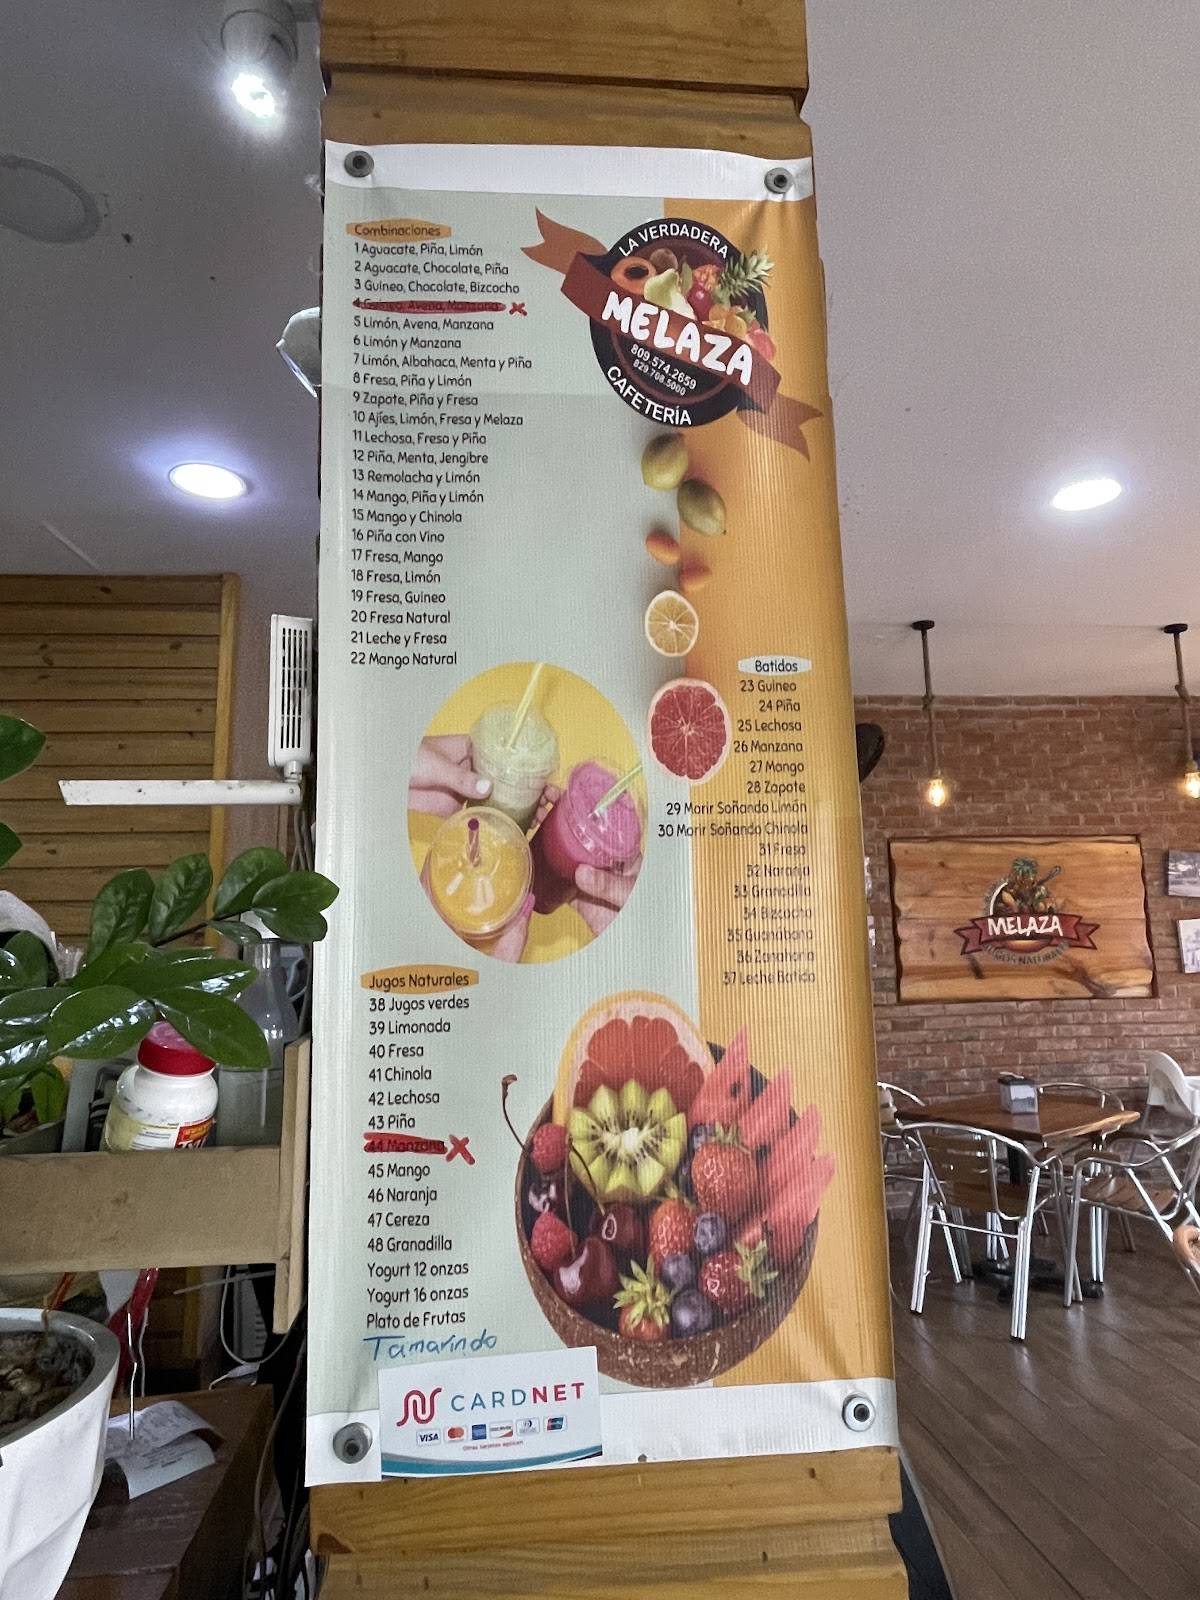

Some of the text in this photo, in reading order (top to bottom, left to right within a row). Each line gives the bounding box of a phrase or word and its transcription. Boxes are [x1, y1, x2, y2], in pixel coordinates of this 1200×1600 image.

[354, 224, 441, 237] Combinaciones
[619, 223, 729, 259] LA VERDADERA
[355, 242, 483, 258] 1 Aguacate, Piña, Limón
[355, 261, 509, 276] 2 Aguacate, Chocolate, Piña
[354, 279, 520, 294] 3 Guineo, Chocolate, Bizcocho
[354, 316, 494, 332] 5 Limón, Avena, Manzana
[354, 335, 462, 351] 6 Limón y Manzana
[602, 291, 753, 386] MELAZA
[354, 353, 532, 372] 7 Limón, Albahaca, Menta y Piña
[631, 344, 697, 390] 809.574.2659
[353, 372, 472, 390] 8 Fresa, Piña y Limón
[353, 391, 478, 409] 9 Zapote, Piña y Fresa
[607, 366, 692, 425] CAFETERÍA
[353, 411, 523, 428] 10 Ajíes, Limón, Fresa y Melaza
[353, 430, 487, 448] 11 Lechosa, Fresa y Piña
[353, 450, 489, 468] 12 Piña, Menta, Jengibre
[353, 470, 480, 487] 13 Remolacha y Limón
[353, 489, 484, 507] 14 Mango, Piña y Limón
[352, 509, 463, 527] 15 Mango y Chinola
[352, 529, 445, 543] 16 Piña con Vino
[352, 549, 444, 567] 17 Fresa, Mango
[352, 569, 441, 584] 18 Fresa, Limón
[351, 590, 446, 605] 19 Fresa, Guineo
[351, 611, 451, 624] 20 Fresa Natural
[351, 632, 447, 648] 21 Leche y Fresa
[351, 652, 457, 669] 22 Mango Natural
[755, 660, 798, 672] Batidos
[740, 680, 797, 692] 23 Guineo
[759, 699, 800, 712] 24 Piña
[738, 719, 802, 732] 25 Lechosa
[734, 741, 803, 753] 26 Manzana
[750, 761, 804, 776] 27 Mango
[748, 781, 806, 796] 28 Zapote
[667, 799, 807, 815] 29 Morir Soñando Limón
[658, 823, 762, 837] 30 Morir Soñando
[988, 916, 1064, 937] MELAZA
[369, 972, 469, 993] Jugos Naturales
[369, 995, 470, 1015] 38 Jugos verdes
[369, 1018, 451, 1035] 39 Limonada
[369, 1044, 424, 1059] 40 Fresa
[369, 1066, 432, 1082] 41 Chinola
[369, 1090, 440, 1106] 42 Lechosa
[369, 1114, 416, 1130] 43 Piña
[368, 1164, 431, 1182] 45 Mango
[368, 1186, 437, 1206] 46 Naranja
[368, 1213, 430, 1227] 47 Cereza
[368, 1235, 452, 1252] 48 Granadilla
[368, 1262, 469, 1282] Yogurt 12 onzas
[367, 1287, 469, 1308] Yogurt 16 onzas
[367, 1311, 466, 1329] Plato de Frutas
[363, 1329, 497, 1361] Tamarindo
[451, 1382, 585, 1412] CARDNET
[419, 1433, 439, 1443] VISA
